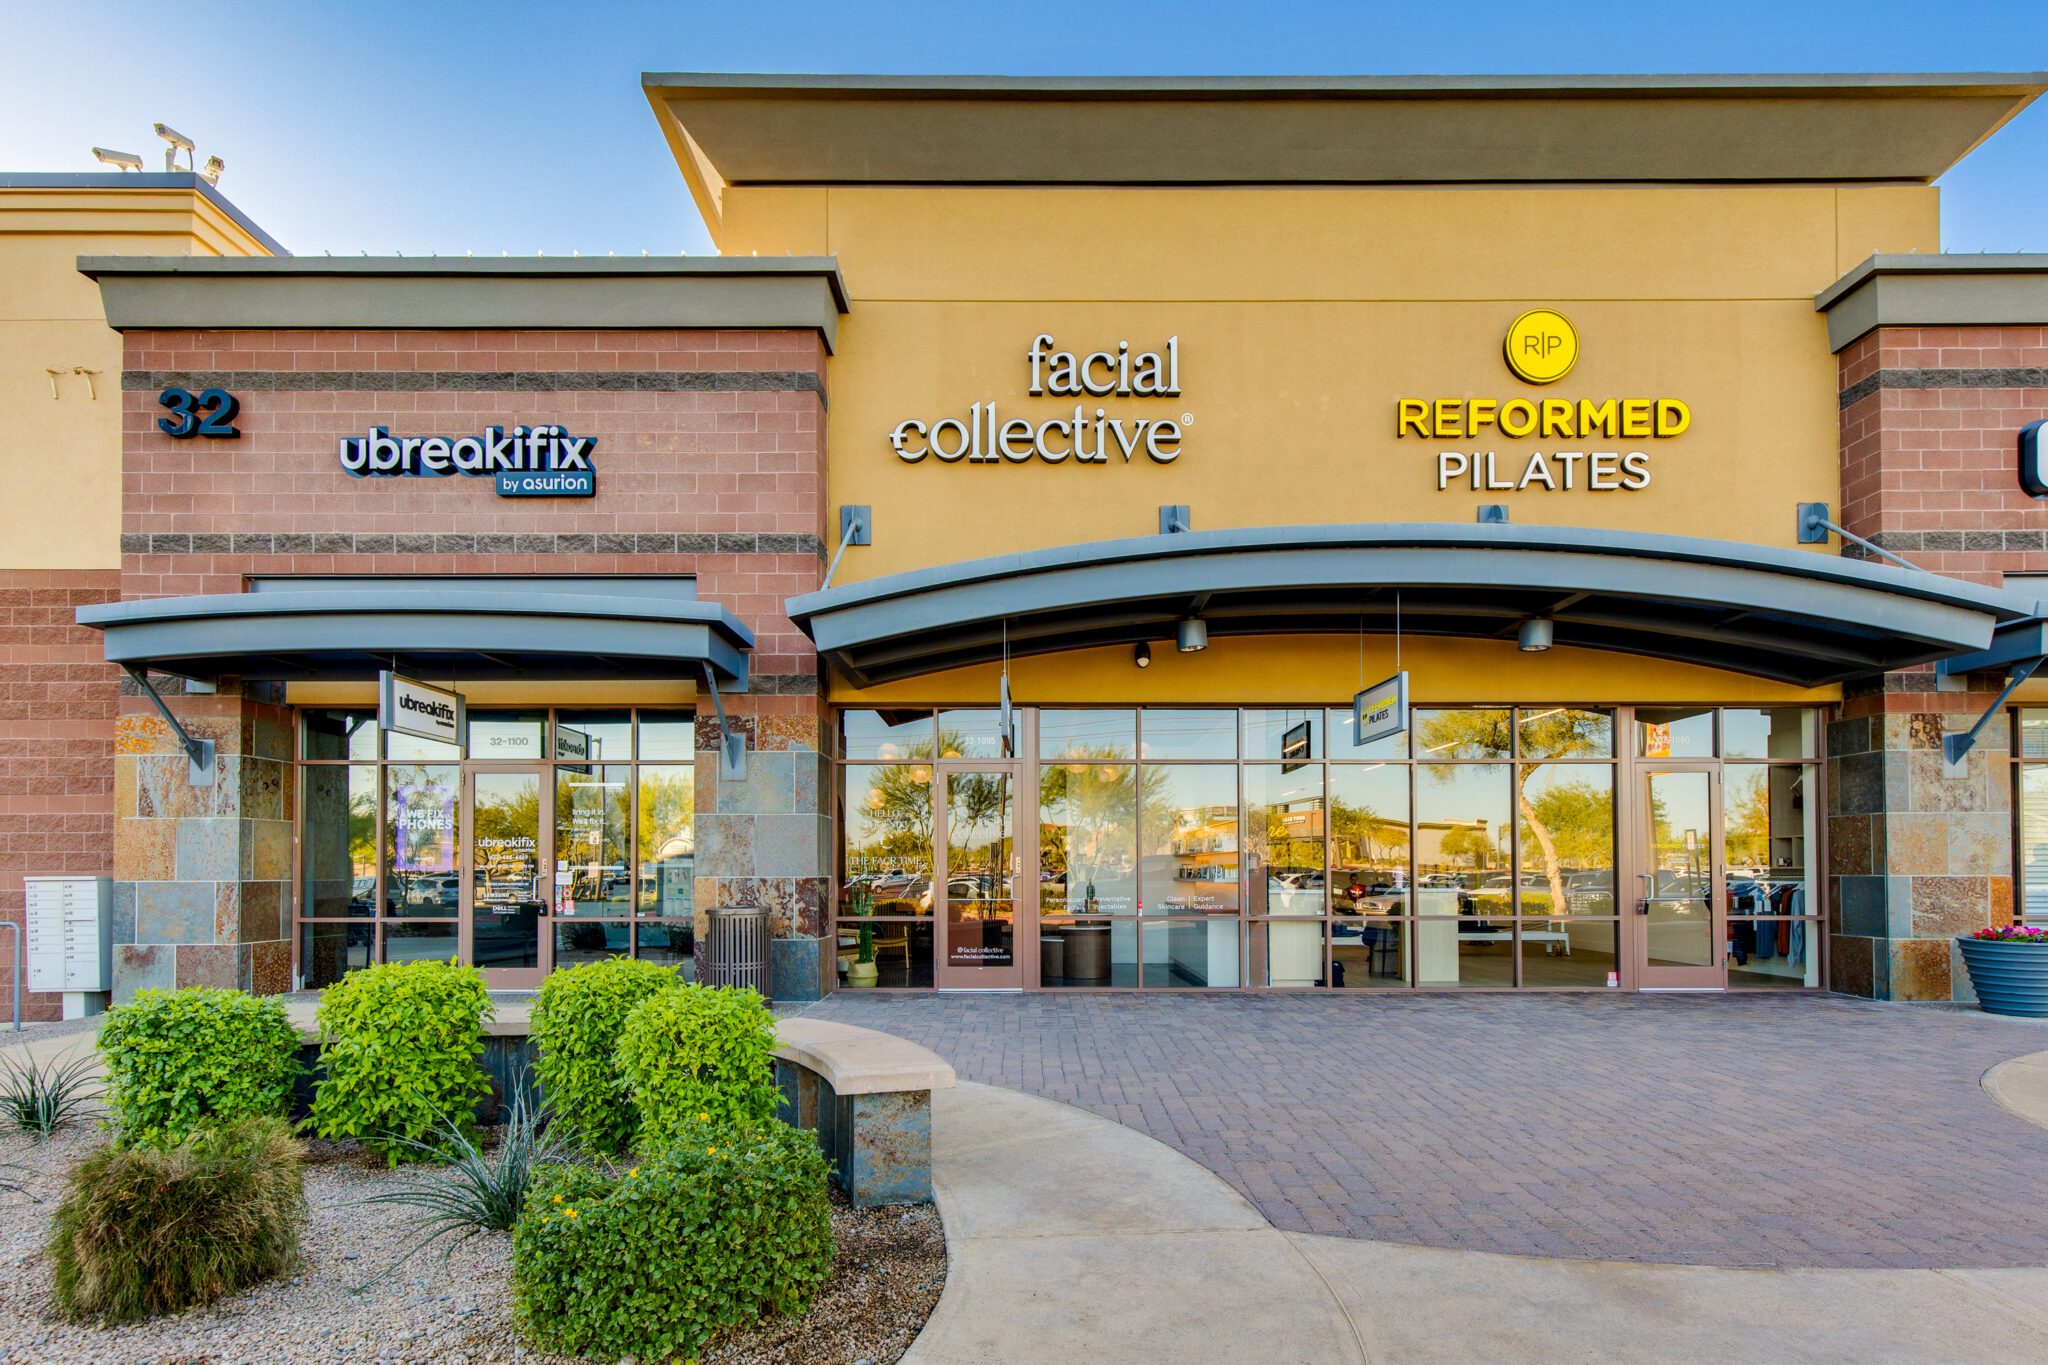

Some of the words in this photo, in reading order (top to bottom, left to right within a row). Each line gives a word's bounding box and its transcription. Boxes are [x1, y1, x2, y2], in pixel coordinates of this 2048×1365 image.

[1028, 333, 1182, 397] facial
[157, 387, 237, 437] 32
[1397, 398, 1692, 438] REFORMED
[339, 426, 592, 471] ubreakifix
[1437, 451, 1651, 491] PILATES
[502, 478, 519, 492] by
[522, 474, 588, 490] asurion
[399, 693, 455, 722] ubreakifix
[490, 737, 528, 746] 32-1100
[400, 818, 452, 830] PHONES
[406, 810, 424, 818] WE
[427, 810, 444, 818] FIX
[478, 836, 536, 848] ubreakifix
[850, 856, 870, 865] THE
